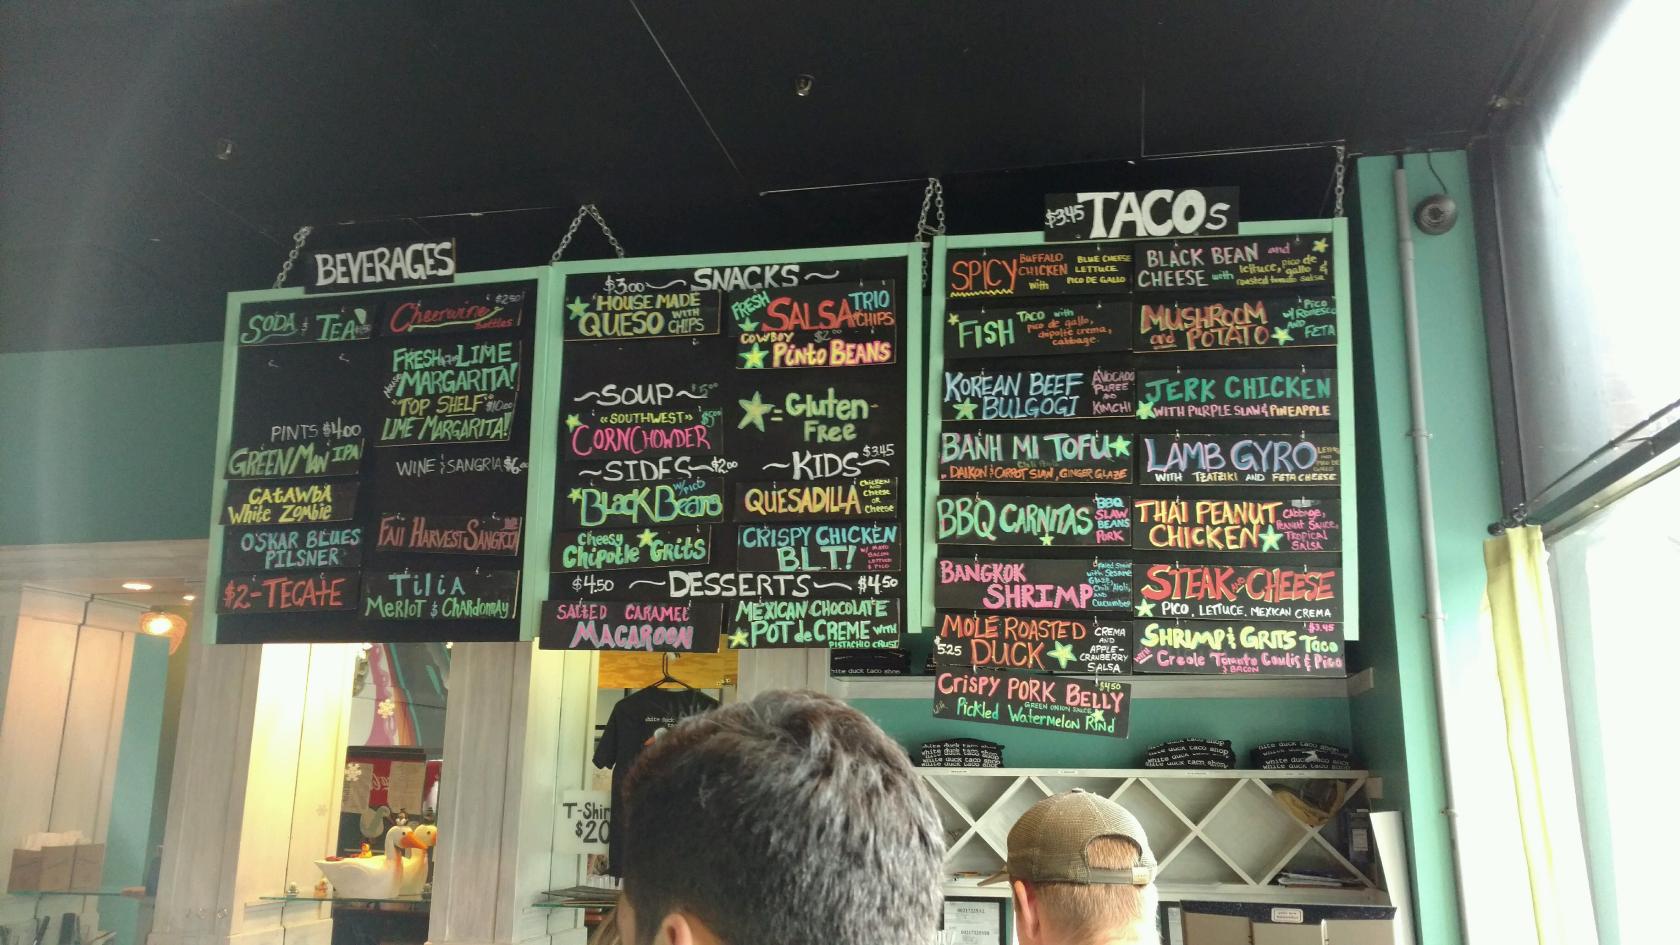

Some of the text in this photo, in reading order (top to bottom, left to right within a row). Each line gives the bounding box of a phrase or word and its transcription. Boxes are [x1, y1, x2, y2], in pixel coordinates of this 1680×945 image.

[315, 242, 454, 285] BEVERAGES
[1102, 254, 1132, 262] CHEESE
[1146, 242, 1290, 268] BLACK BEAN and
[1302, 254, 1317, 264] de
[690, 265, 800, 292] SNACKS
[951, 258, 1017, 290] SPICY
[1018, 263, 1068, 276] CHICKEN
[1085, 276, 1098, 284] DE
[1137, 269, 1209, 288] CHEESE
[596, 292, 701, 311] HOUSE MADE
[731, 290, 771, 321] FRESH
[848, 290, 890, 311] TRIO
[578, 311, 665, 338] QUESO
[671, 308, 700, 319] WITH
[761, 296, 856, 331] SALSA
[857, 311, 895, 327] CHIPS
[1016, 310, 1046, 322] TACO
[1140, 300, 1269, 334] MUSHROOM
[240, 312, 298, 343] SODA
[315, 313, 356, 341] TEA
[668, 318, 705, 334] CHIPS
[740, 332, 795, 344] COWBOY
[1186, 324, 1270, 350] POTATO
[1304, 324, 1336, 338] FETA
[392, 347, 443, 372] FRESH
[455, 342, 513, 368] LIME
[829, 338, 892, 367] BEANS
[395, 362, 519, 398] MARGARITA!
[944, 372, 1085, 402] KOREAN BEEF
[1091, 370, 1135, 385] AVOCADO
[1145, 376, 1331, 402] JERK CHICKEN
[597, 383, 674, 406] SOUP
[785, 387, 869, 420] Gluten
[982, 396, 1080, 420] BULGOGI
[1092, 400, 1131, 415] KIMCHI
[1152, 406, 1185, 417] WITH
[1233, 405, 1262, 417] SLAW
[1270, 405, 1331, 417] PINEAPPLE
[271, 424, 318, 442] PINTS
[380, 412, 513, 442] LIME MARGARITA!
[331, 444, 359, 462] IPA
[940, 433, 1113, 464] BANH MI TOFU
[1144, 438, 1318, 473] LAMB GYRO
[228, 447, 296, 477] GREEN
[396, 456, 504, 477] WINE SANGRIA
[603, 456, 692, 481] SIDES
[792, 450, 862, 480] KIDS
[1059, 468, 1093, 479] GINGER
[1094, 468, 1128, 480] GLAZE
[1155, 472, 1183, 482] WITH
[1245, 473, 1265, 482] AND
[1272, 473, 1297, 482] FETA
[1298, 473, 1337, 482] CHEESE
[744, 485, 862, 515] QUESADILLA
[1096, 497, 1124, 508] BBQ
[228, 504, 272, 525] White
[937, 497, 1094, 542] BBQ CARNITAS
[1094, 509, 1129, 521] SLAW
[1097, 518, 1130, 529] BEANS
[1134, 500, 1283, 525] THAI PEANUT
[240, 528, 361, 553] OSKAR BLUES
[408, 516, 466, 549] HARVEST
[742, 525, 897, 548] CRISPY CHICKEN
[1149, 523, 1260, 550] CHICKEN
[265, 548, 340, 569] PILSNER
[562, 543, 640, 569] Chipotle
[940, 559, 1026, 584] BANGKOK
[1140, 563, 1336, 602] STEAK CHEESE
[669, 570, 811, 598] DESSERTS
[982, 583, 1094, 609] SHRIMP
[735, 599, 890, 622] MEXICAN CHOCOLATE
[1250, 606, 1331, 619] MEXICAN CREMA
[569, 621, 694, 651] MACAROON
[751, 620, 795, 648] POT
[813, 619, 871, 641] CREME
[873, 623, 897, 635] WITH
[940, 614, 1087, 641] MOLE ROASTED
[1094, 627, 1126, 637] CREMA
[1140, 623, 1297, 651] SHRIMP GRITS
[829, 640, 871, 649] PISTACHIO
[970, 638, 1045, 670] DUCK
[1079, 653, 1129, 662] CRANBERRY
[1087, 662, 1122, 674] SALSA
[1156, 650, 1206, 667] Creole
[1229, 665, 1259, 673] BACON
[1007, 677, 1124, 714] PORK BELLY
[1024, 701, 1048, 710] GREEN
[563, 802, 610, 820] T-Shir
